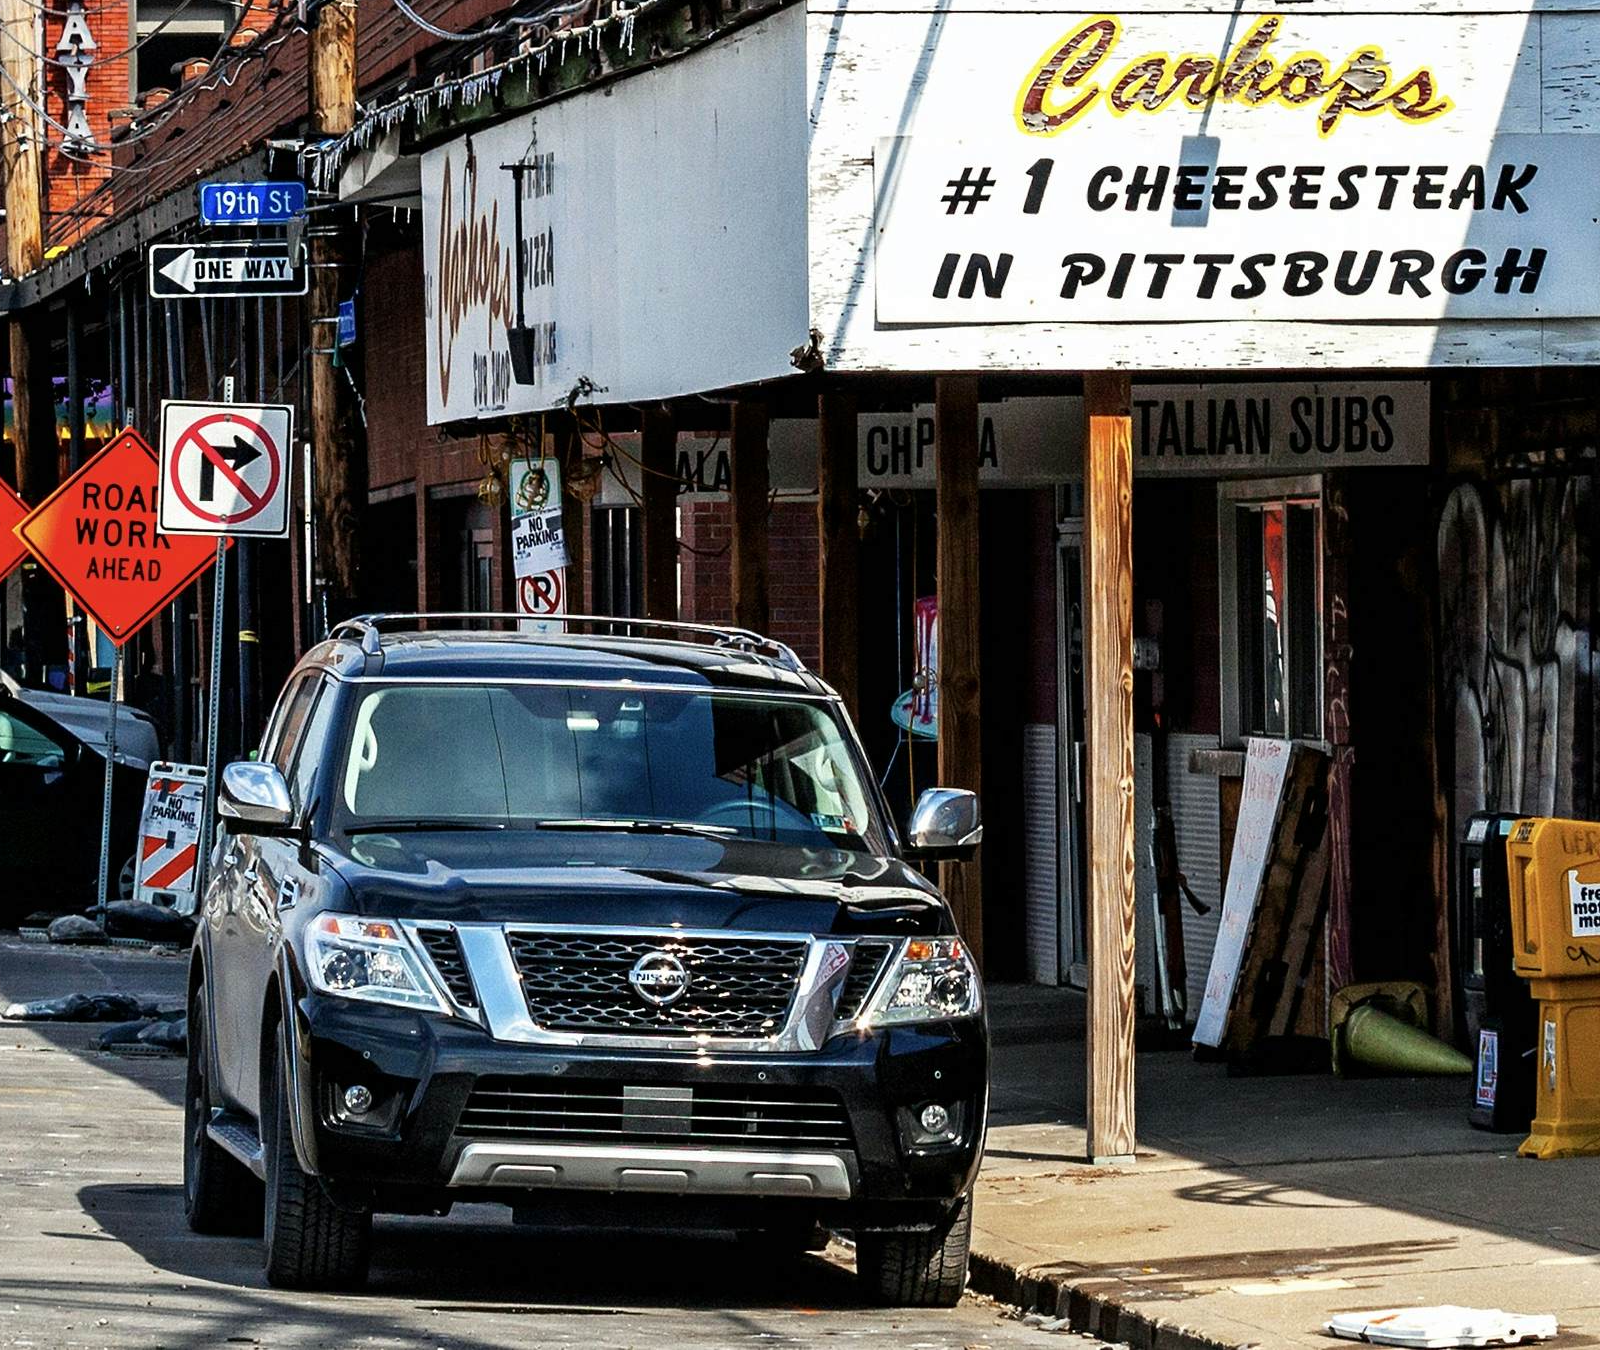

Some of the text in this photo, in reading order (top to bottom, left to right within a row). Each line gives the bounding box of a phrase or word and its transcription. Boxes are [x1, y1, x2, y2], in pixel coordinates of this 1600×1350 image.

[1016, 15, 1455, 138] Carhops
[939, 158, 1537, 215] # 1 CHEESESTEAK
[215, 191, 292, 215] 19th St
[195, 259, 287, 280] ONE WAY
[932, 247, 1548, 300] IN PITTSBURGH
[1133, 394, 1396, 457] TALIAN SUBS
[75, 518, 171, 549] WORK
[528, 516, 543, 532] NO
[515, 530, 559, 551] PARKING
[86, 557, 161, 582] AHEAD
[151, 805, 195, 823] PARKING
[167, 797, 183, 810] NO
[636, 973, 685, 983] NISAN
